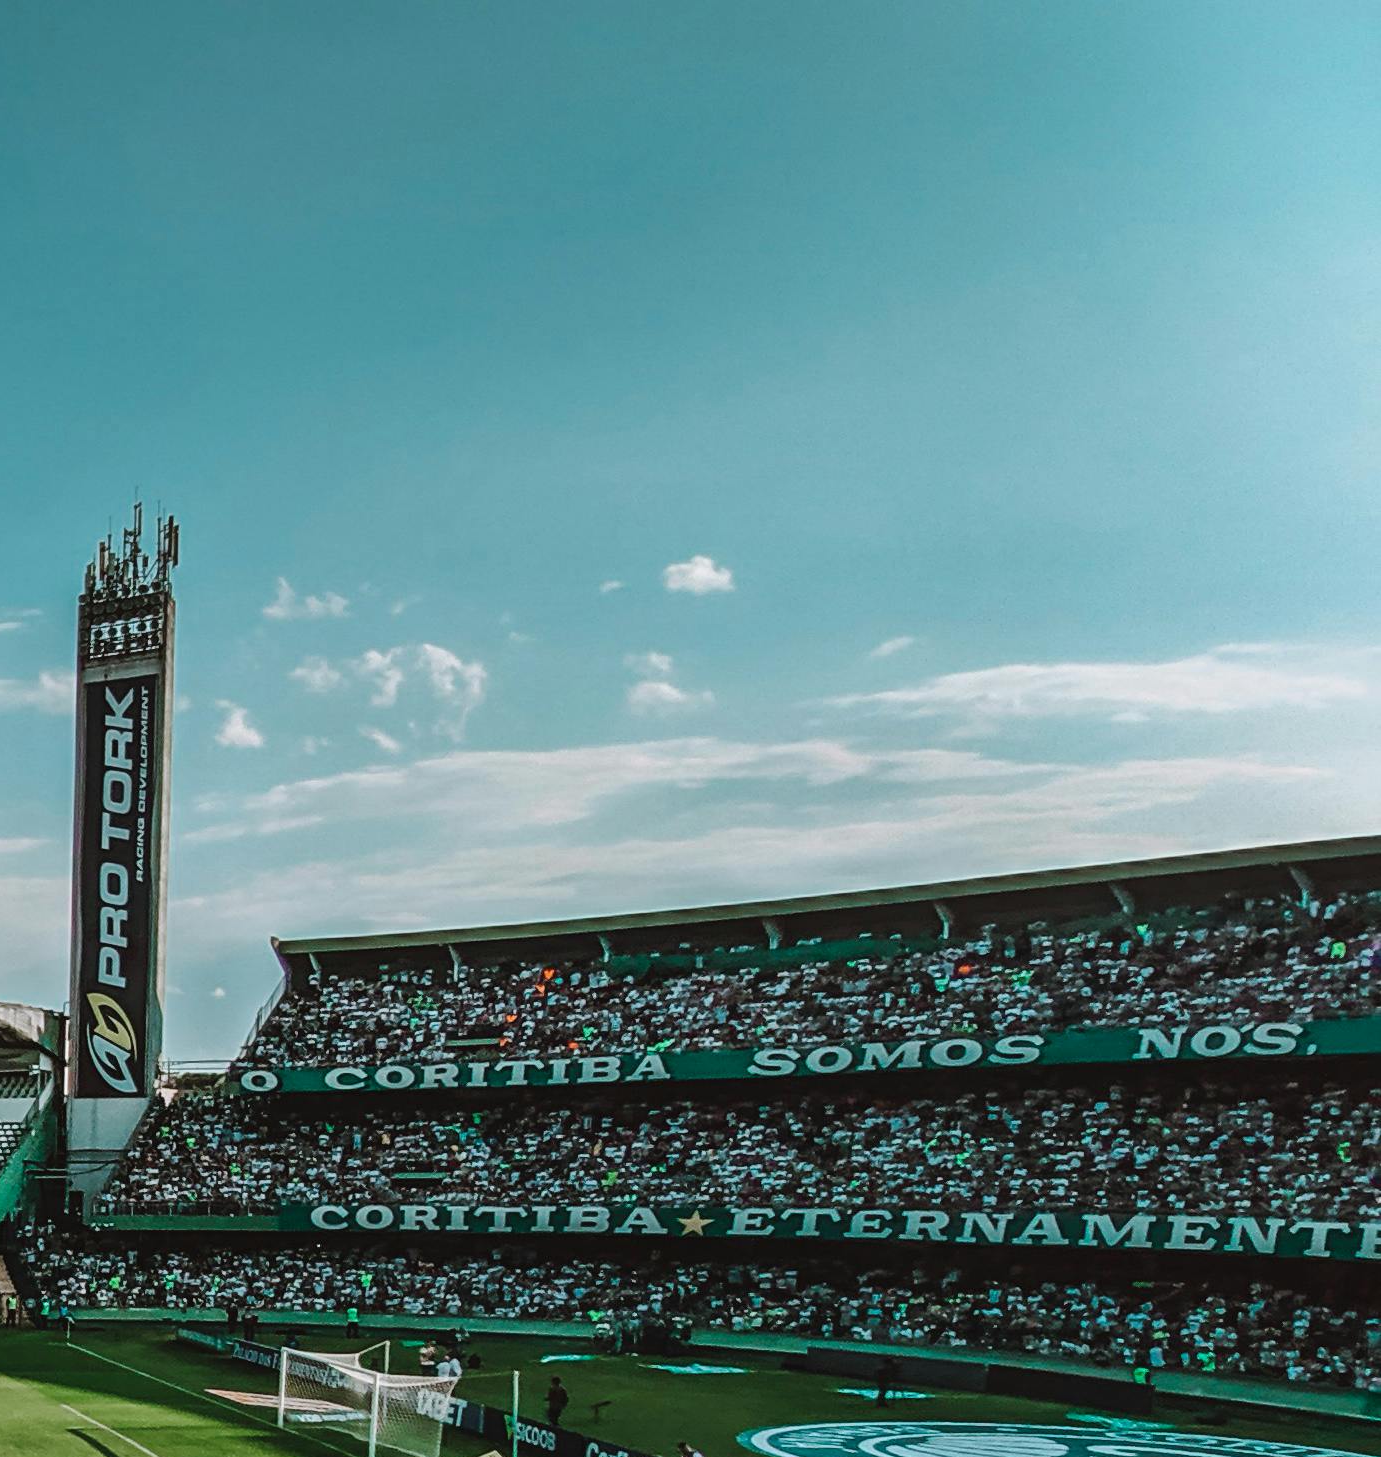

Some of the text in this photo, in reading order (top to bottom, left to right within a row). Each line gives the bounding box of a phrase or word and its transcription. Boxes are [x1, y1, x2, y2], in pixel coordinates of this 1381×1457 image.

[98, 687, 135, 988] PRO TORK
[135, 685, 149, 883] RACING DEVELOPMENT
[241, 1069, 278, 1092] O
[324, 1052, 671, 1090] CORITIBA
[747, 1034, 1046, 1076] SOMOS
[310, 1204, 669, 1235] CORITIBA
